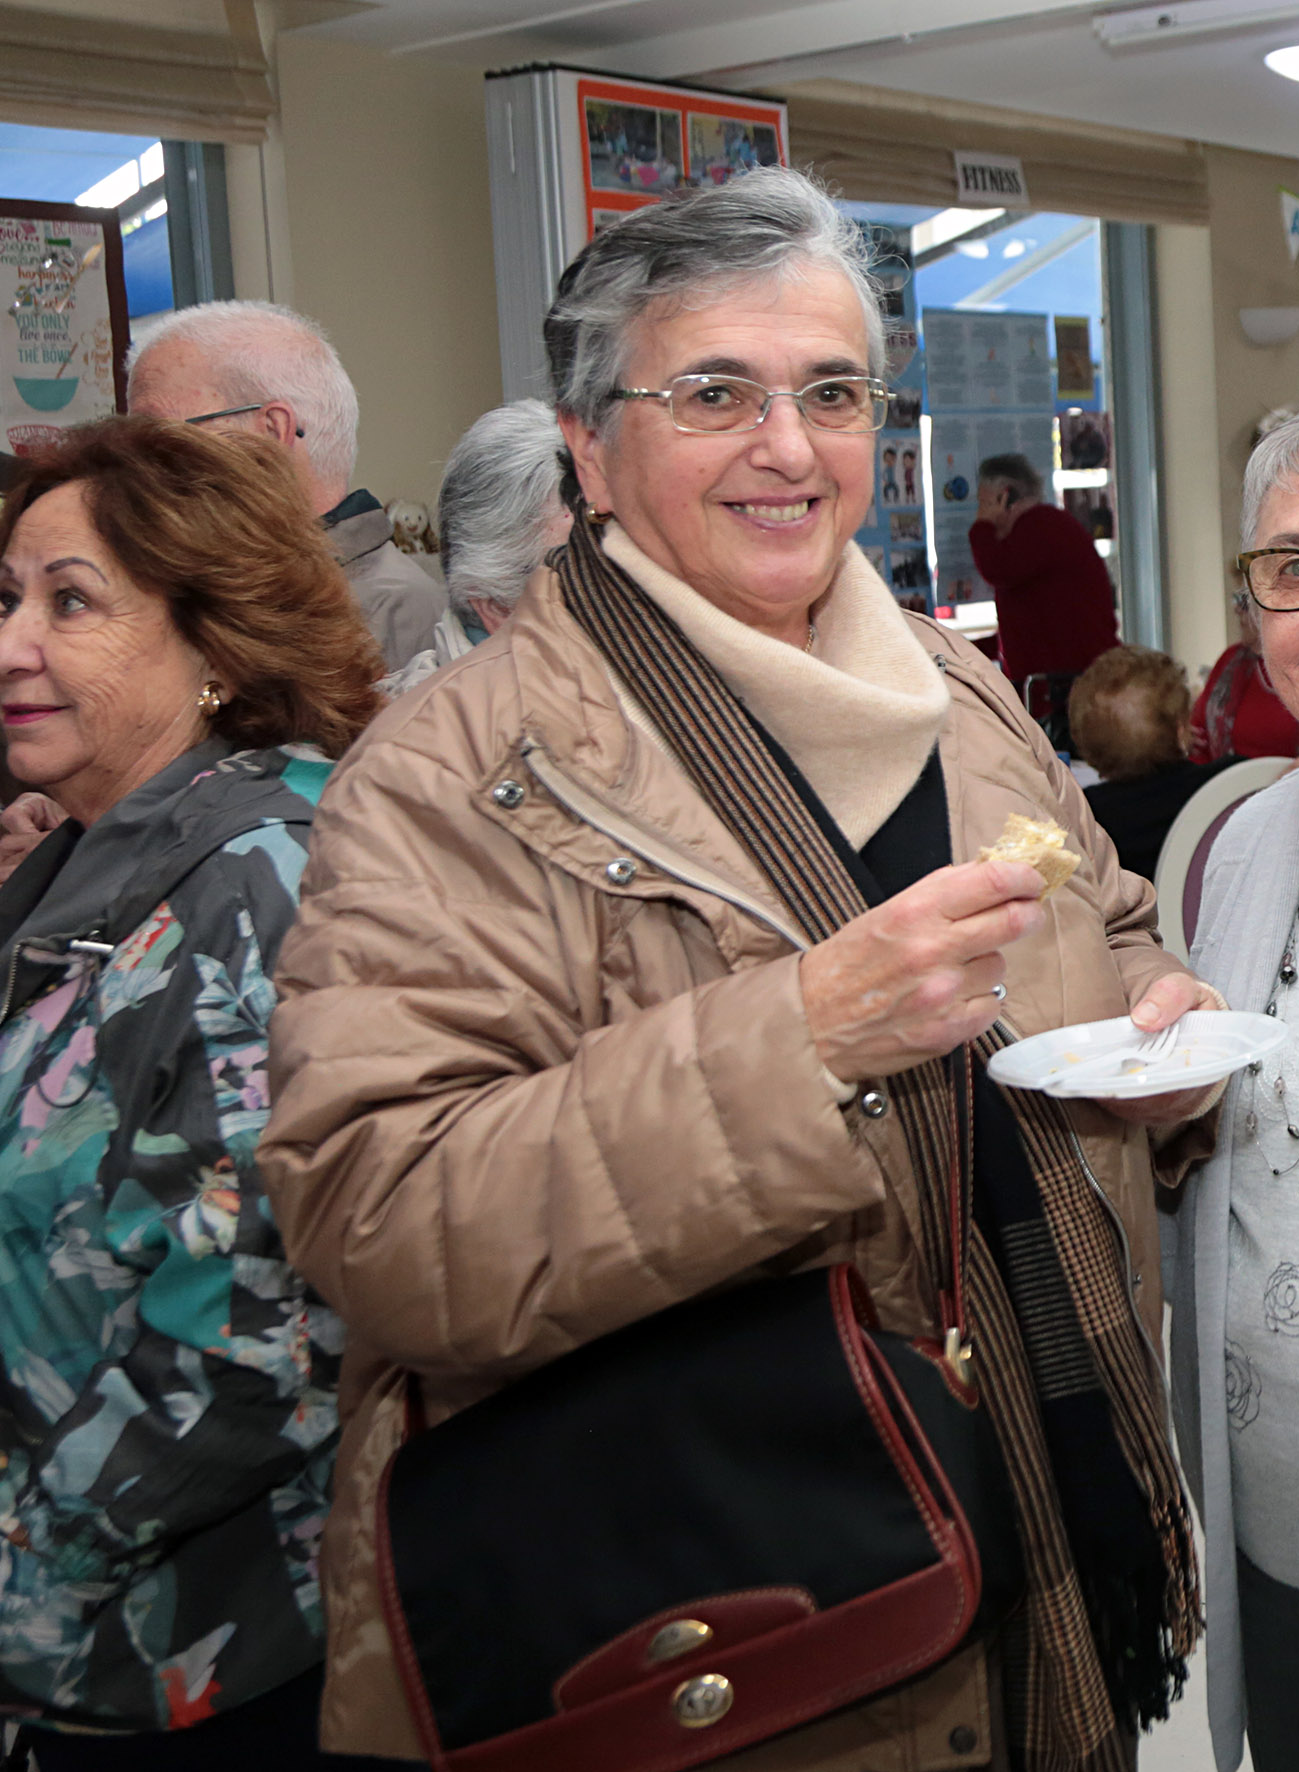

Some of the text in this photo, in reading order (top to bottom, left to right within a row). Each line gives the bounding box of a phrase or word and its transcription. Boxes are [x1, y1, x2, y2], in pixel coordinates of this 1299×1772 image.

[962, 163, 1022, 195] FITNESS
[41, 313, 70, 330] ONLY
[18, 349, 39, 363] THE
